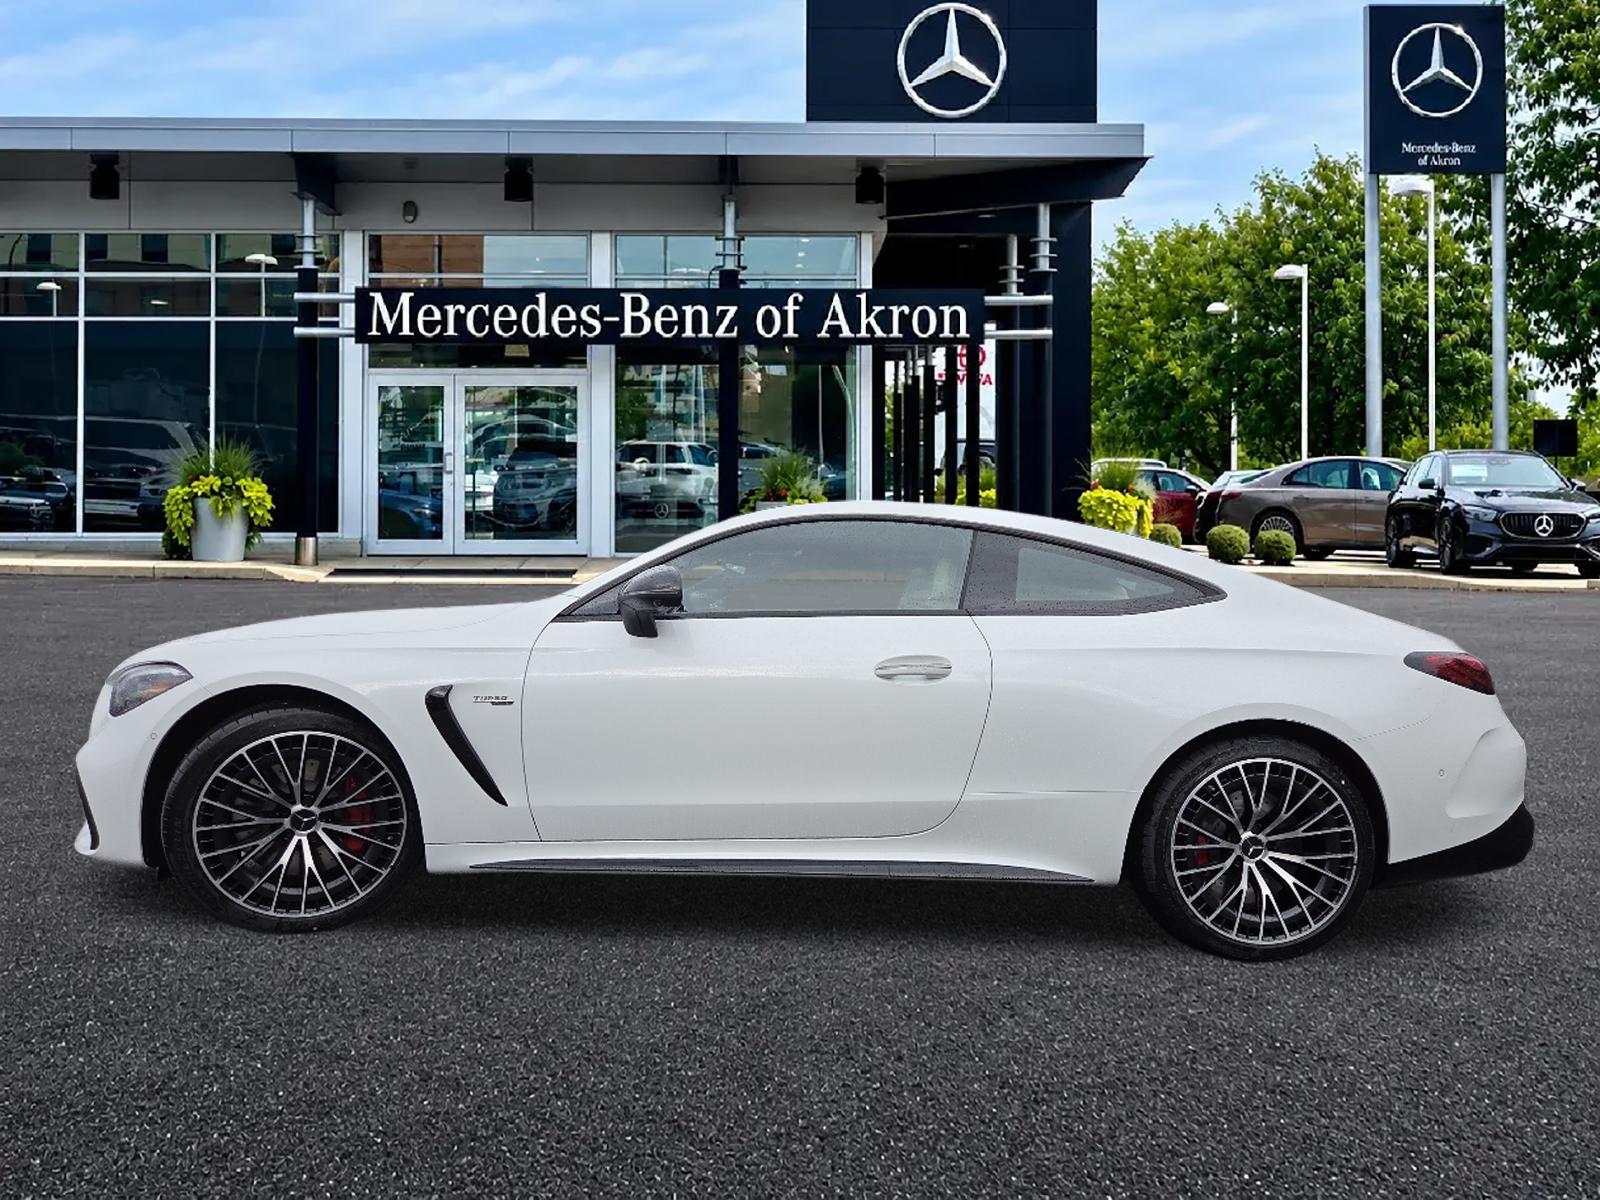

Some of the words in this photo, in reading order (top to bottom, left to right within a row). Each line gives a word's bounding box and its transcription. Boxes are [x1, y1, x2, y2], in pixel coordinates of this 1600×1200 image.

[1401, 142, 1476, 153] Mercedes-Benz
[1417, 154, 1428, 166] of
[1429, 154, 1461, 166] Akron
[367, 291, 738, 339] Mercedes-Benz
[755, 291, 804, 339] of
[816, 291, 970, 339] Akron
